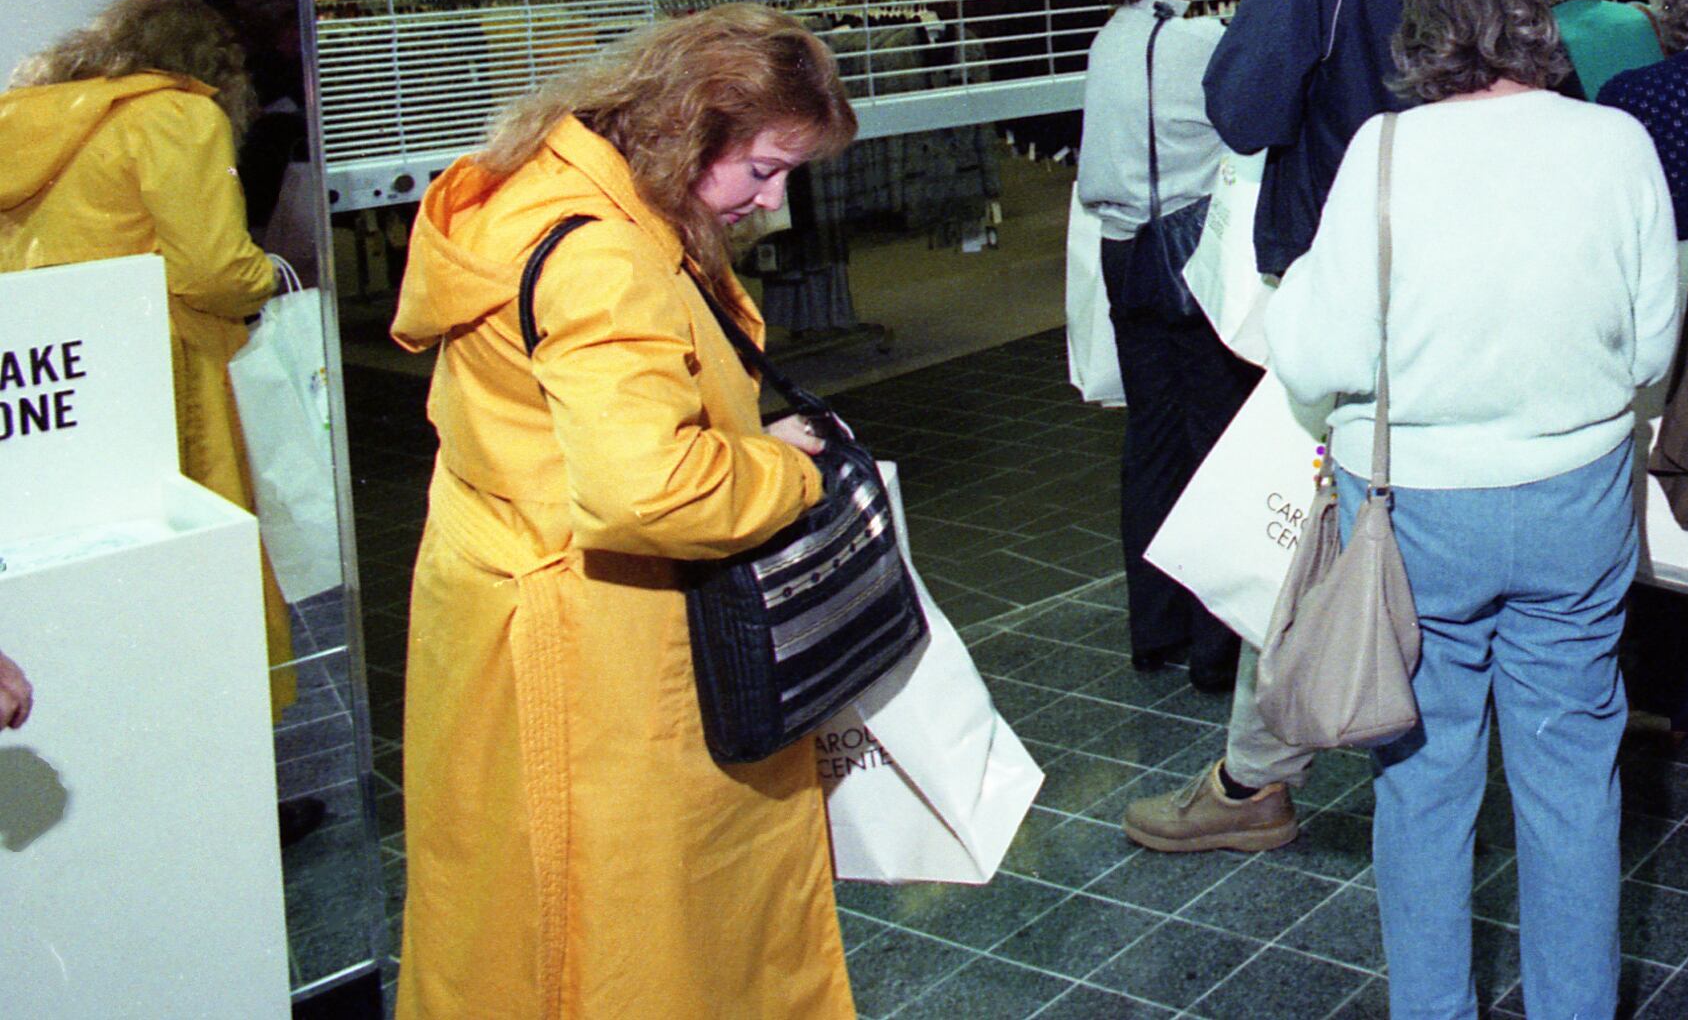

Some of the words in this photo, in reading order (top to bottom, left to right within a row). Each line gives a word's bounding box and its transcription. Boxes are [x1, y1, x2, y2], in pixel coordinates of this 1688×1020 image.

[0, 339, 87, 391] AKE
[1266, 520, 1299, 550] CEN
[814, 723, 879, 755] AROU
[817, 745, 895, 779] CENTE
